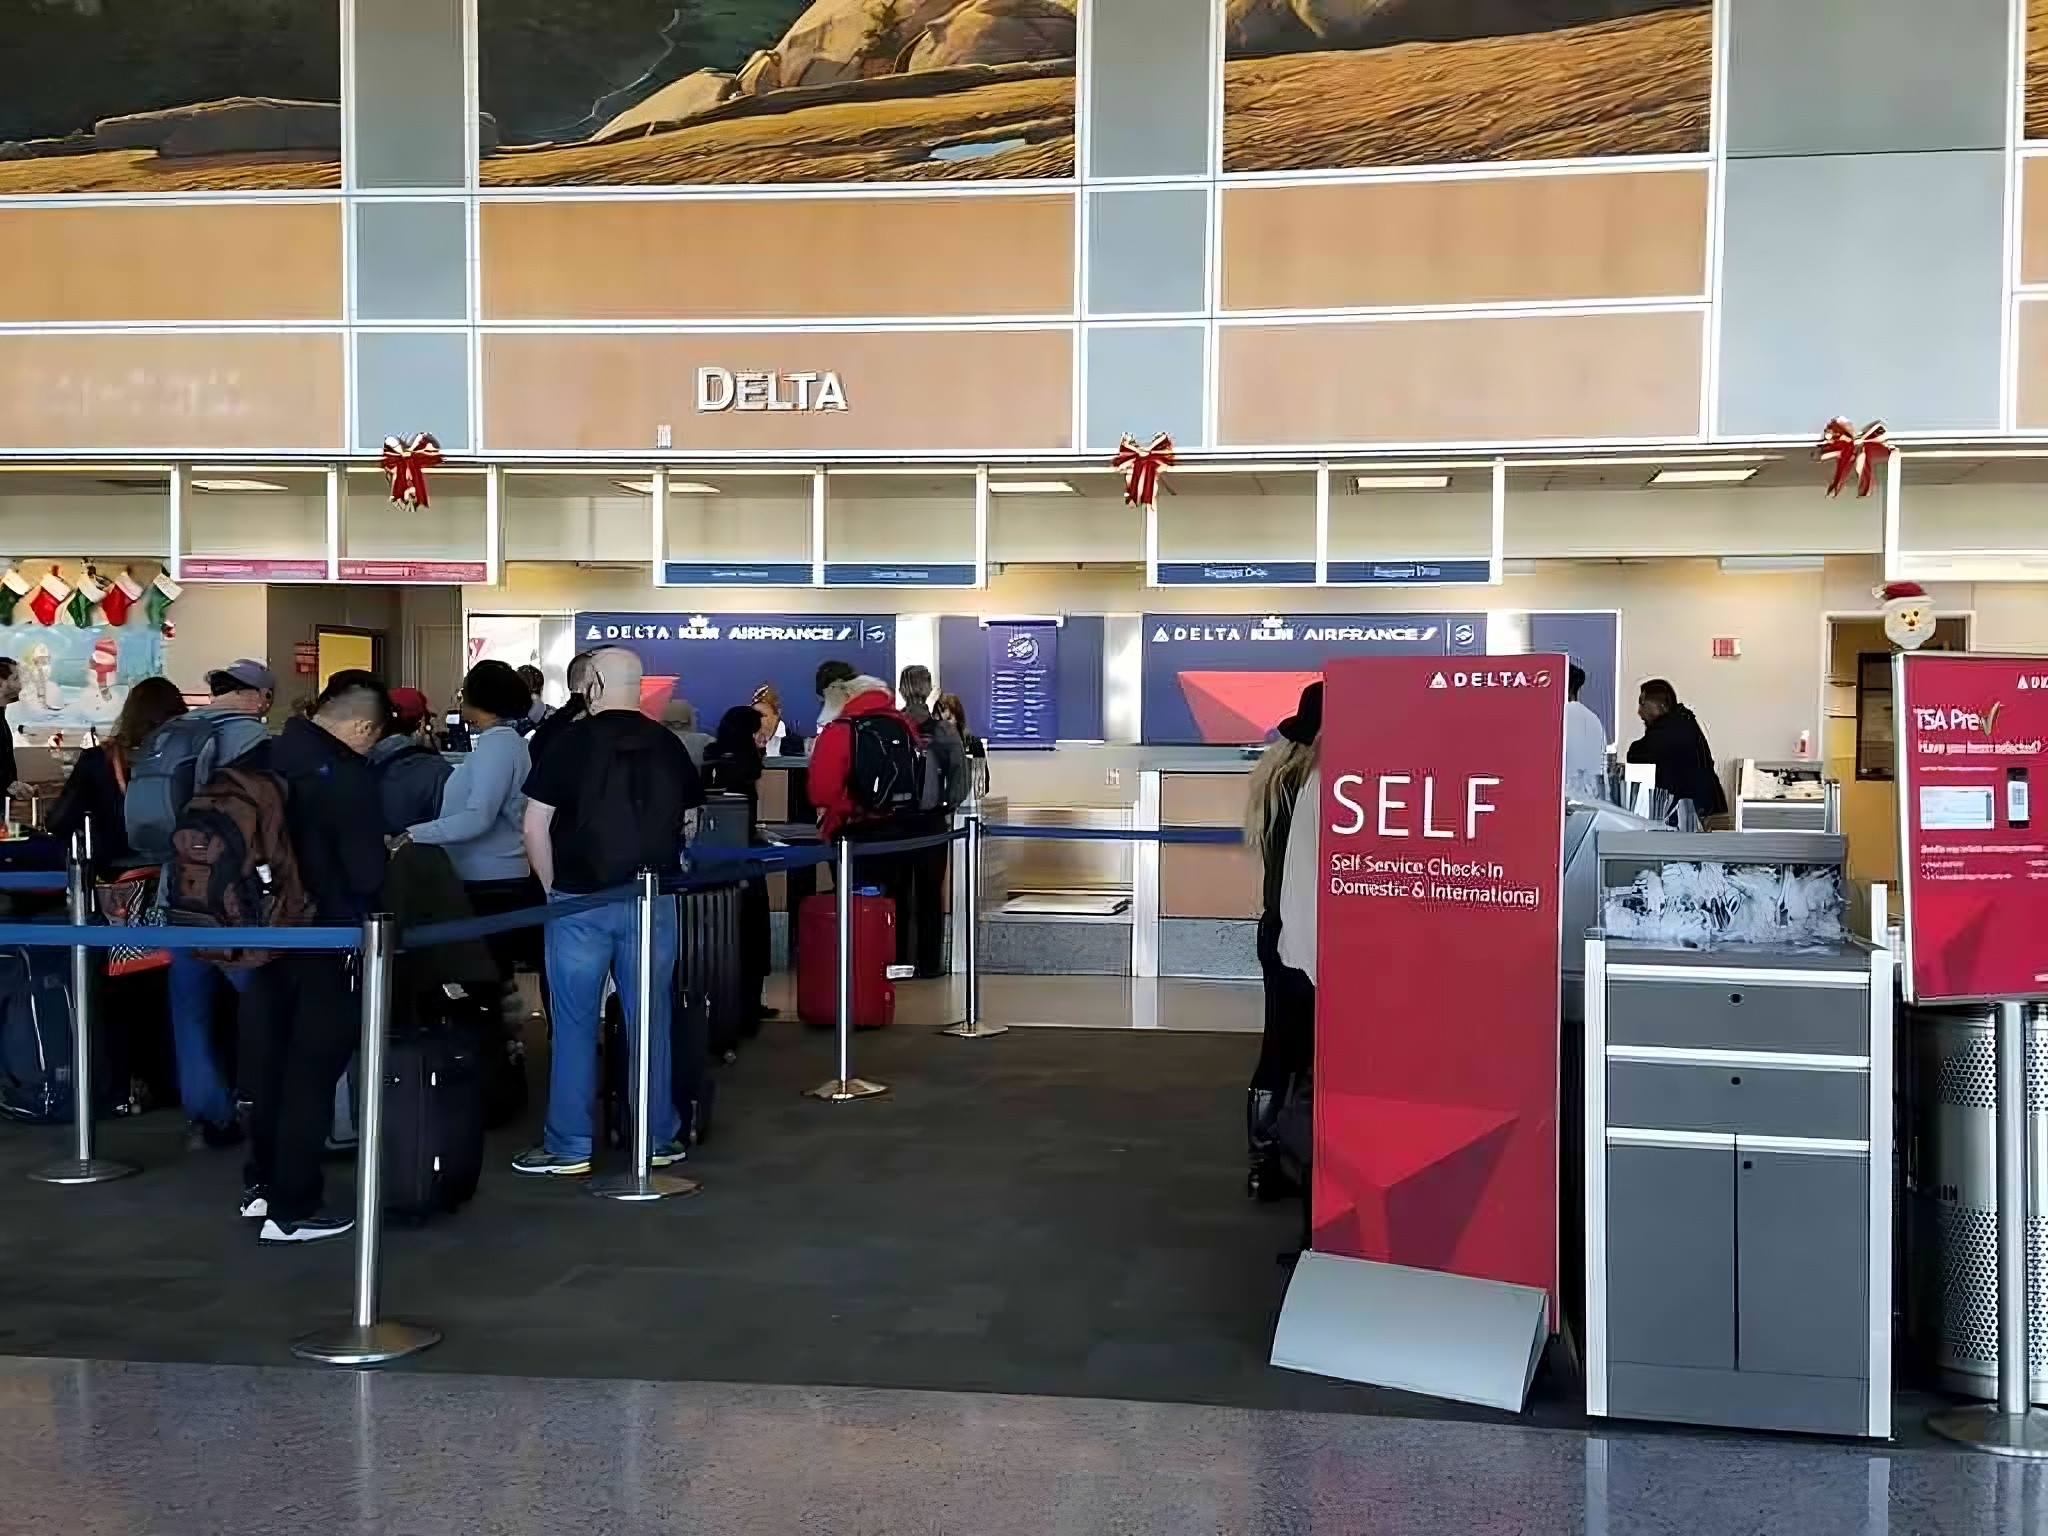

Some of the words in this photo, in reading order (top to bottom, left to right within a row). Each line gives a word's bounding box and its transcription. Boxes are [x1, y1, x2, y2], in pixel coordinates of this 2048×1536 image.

[698, 367, 849, 412] DELTA
[606, 625, 670, 640] DELTA
[728, 626, 836, 641] AIRFRANCE
[1173, 626, 1241, 641] DELTA
[1303, 626, 1419, 641] AIRFRANCE
[1453, 671, 1528, 688] DELTA
[1913, 707, 1949, 731] TSA
[1331, 774, 1501, 839] SELF
[1331, 853, 1361, 872] Self
[1363, 855, 1424, 875] Service
[1330, 877, 1409, 898] Domestic
[1411, 880, 1424, 898] &
[1431, 881, 1540, 907] International
